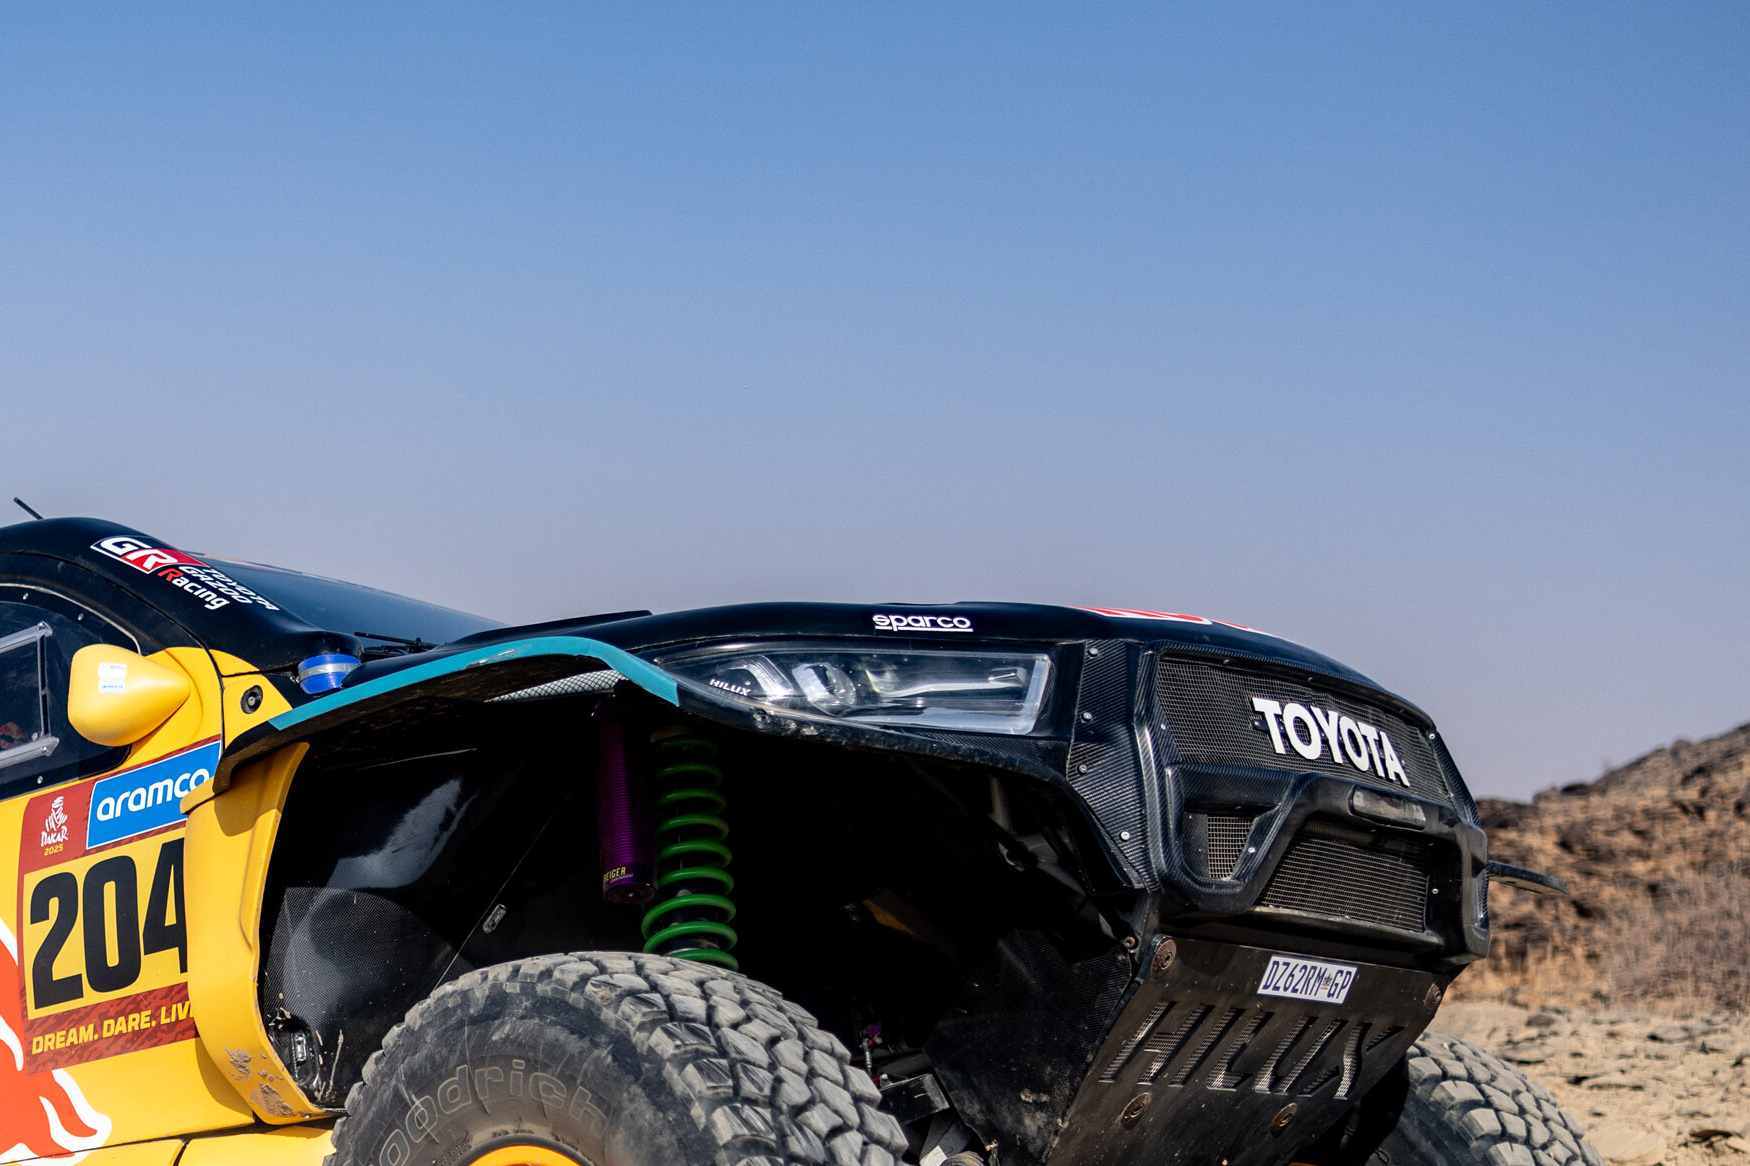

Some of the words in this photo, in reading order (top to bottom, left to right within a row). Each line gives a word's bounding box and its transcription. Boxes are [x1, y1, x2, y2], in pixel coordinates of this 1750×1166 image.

[100, 537, 179, 570] GR
[157, 568, 231, 610] Racing
[178, 566, 253, 604] GAZOO
[204, 567, 281, 611] TOYOTA
[872, 614, 972, 632] sparco
[708, 678, 752, 697] HILUX
[1252, 697, 1411, 788] TOYOTA
[96, 767, 211, 823] aramco
[40, 825, 69, 848] DAKAR
[43, 843, 64, 857] 2025
[603, 866, 627, 882] EIGER
[29, 838, 188, 1010] 204
[1262, 960, 1328, 997] DZ62RM
[1327, 969, 1353, 1000] GP
[31, 1021, 99, 1056] DREAM.
[102, 1009, 157, 1039] DARE.
[1097, 999, 1406, 1101] HILUX
